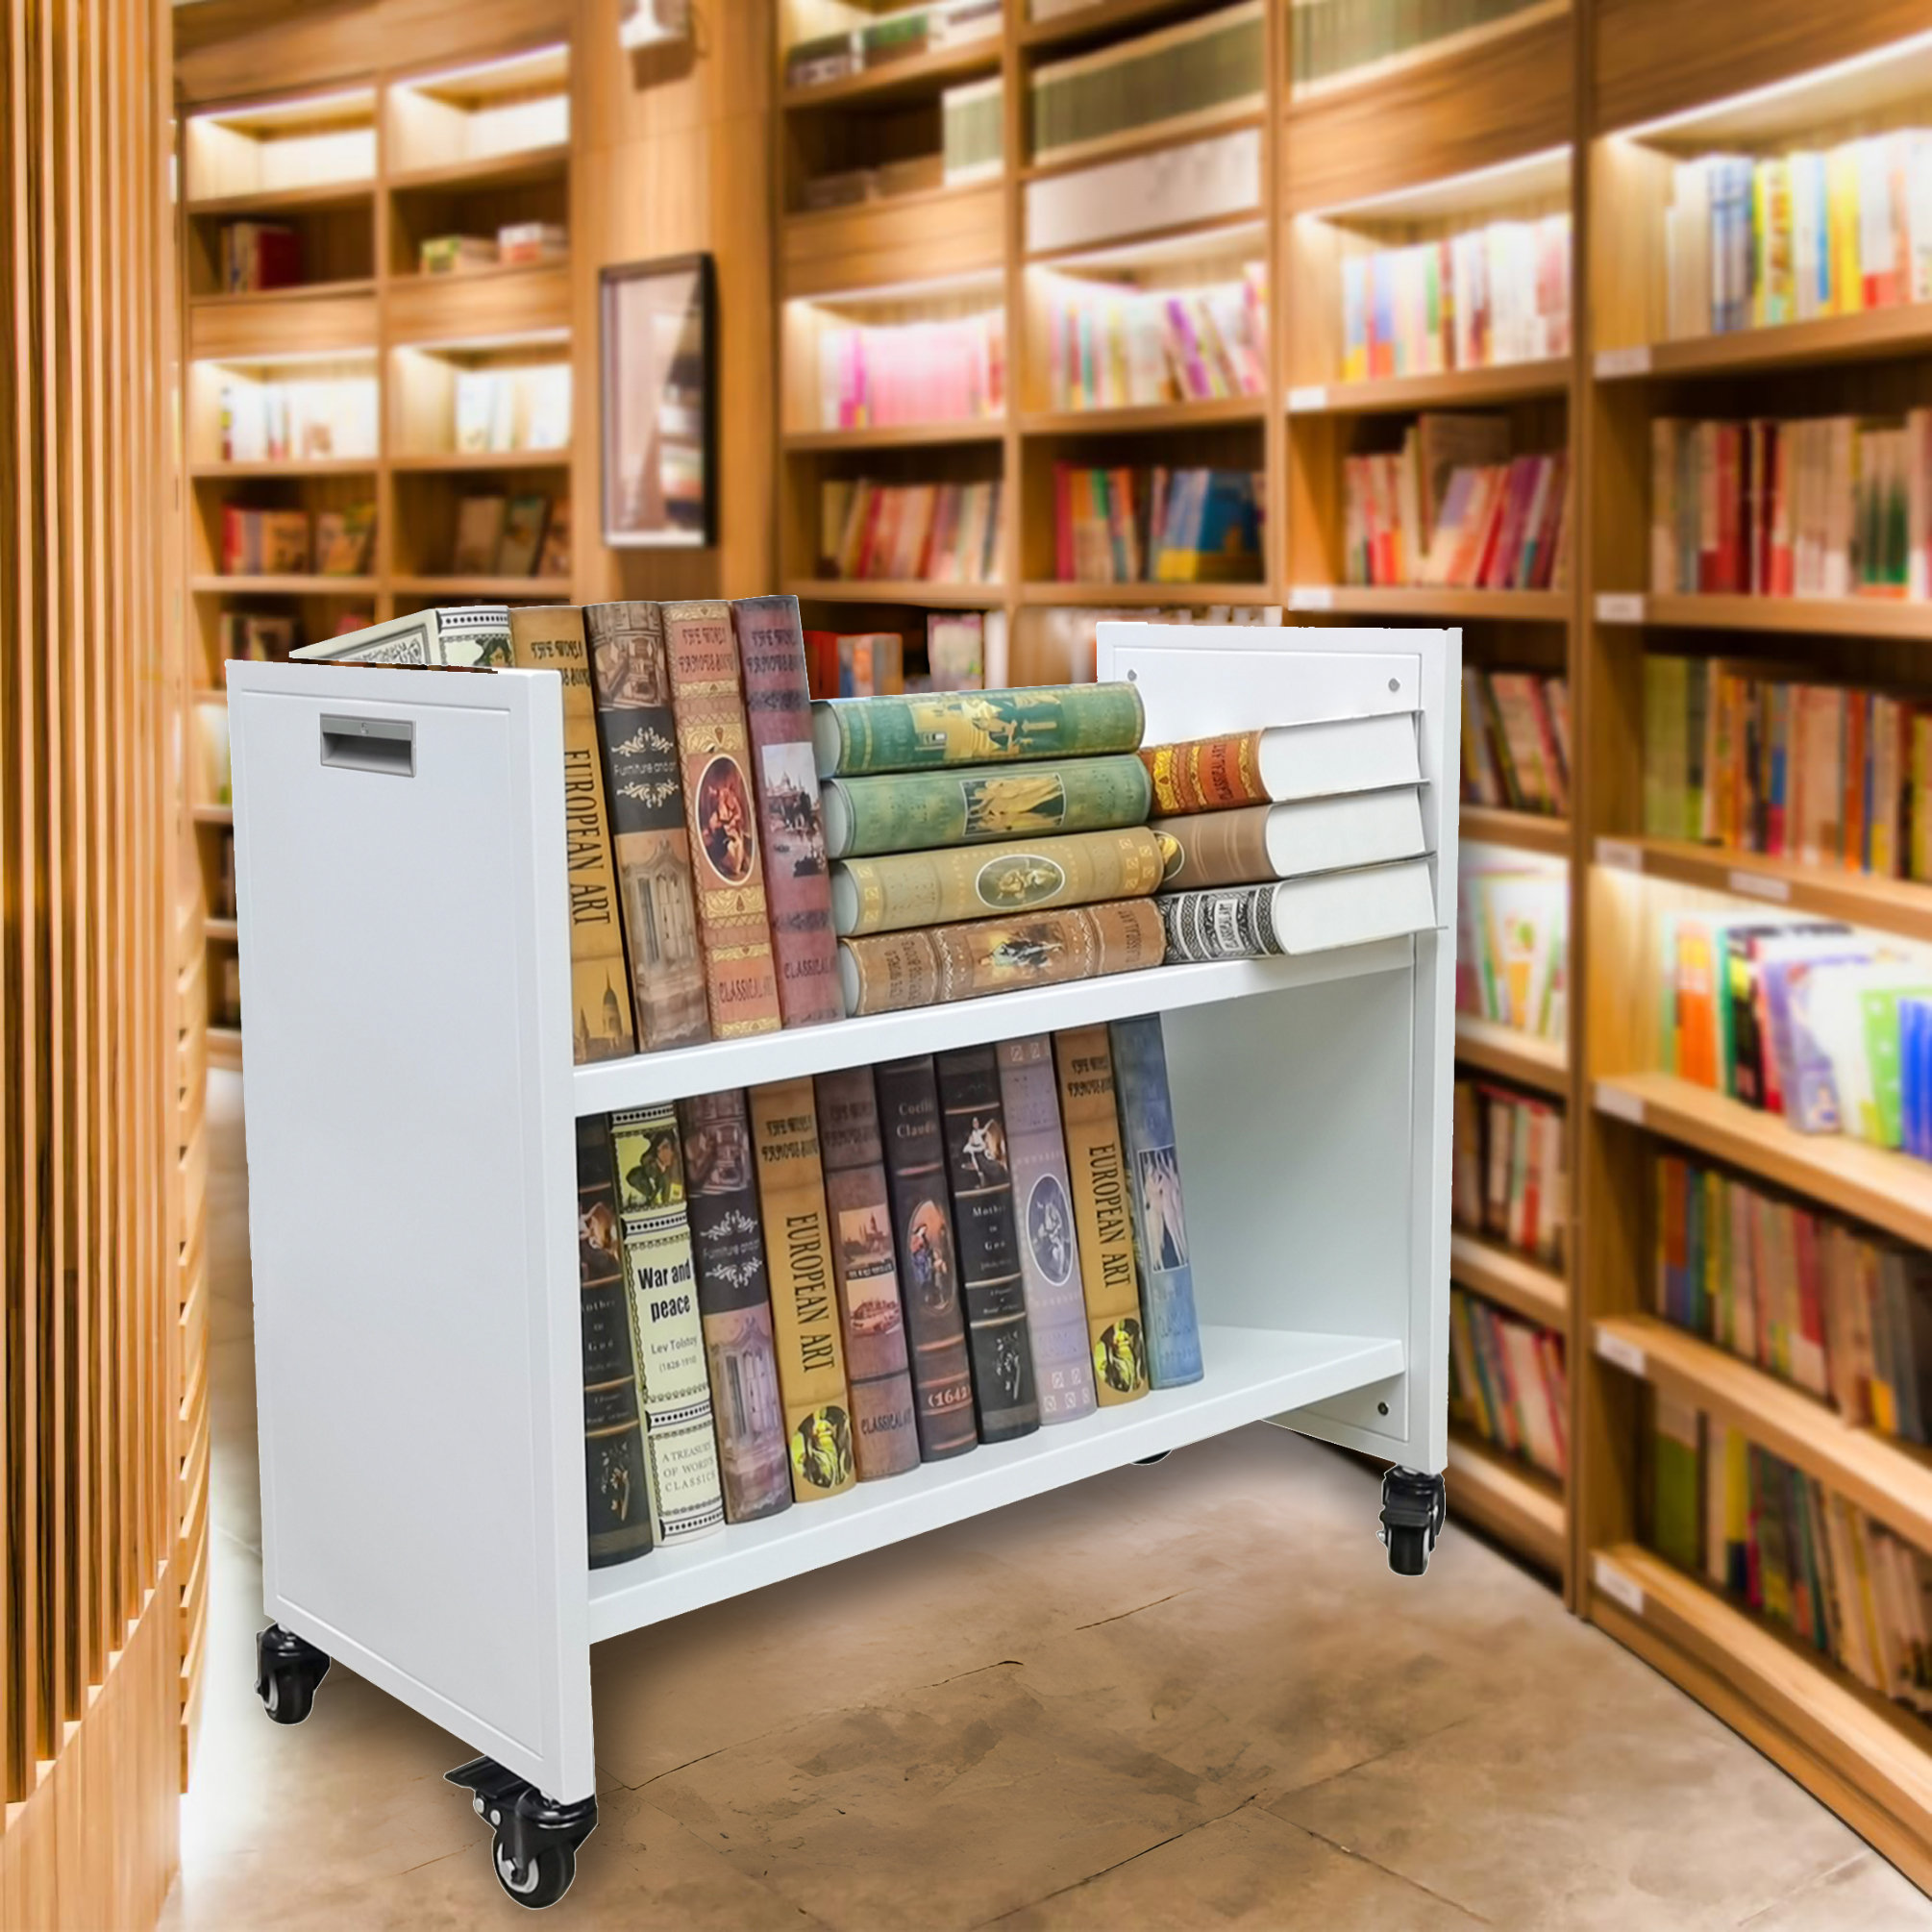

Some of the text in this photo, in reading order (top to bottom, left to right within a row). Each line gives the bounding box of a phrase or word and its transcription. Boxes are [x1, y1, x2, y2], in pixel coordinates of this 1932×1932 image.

[569, 883, 610, 926] ART
[1088, 1143, 1131, 1289] EUROPEAN ART
[638, 1257, 692, 1290] War and
[785, 1212, 835, 1374] EUROPEAN ART
[650, 1295, 691, 1323] peace
[650, 1335, 698, 1355] Lev Tolstoy
[662, 1453, 670, 1463] A
[663, 1467, 678, 1478] OF
[664, 1471, 716, 1493] CLASSICS
